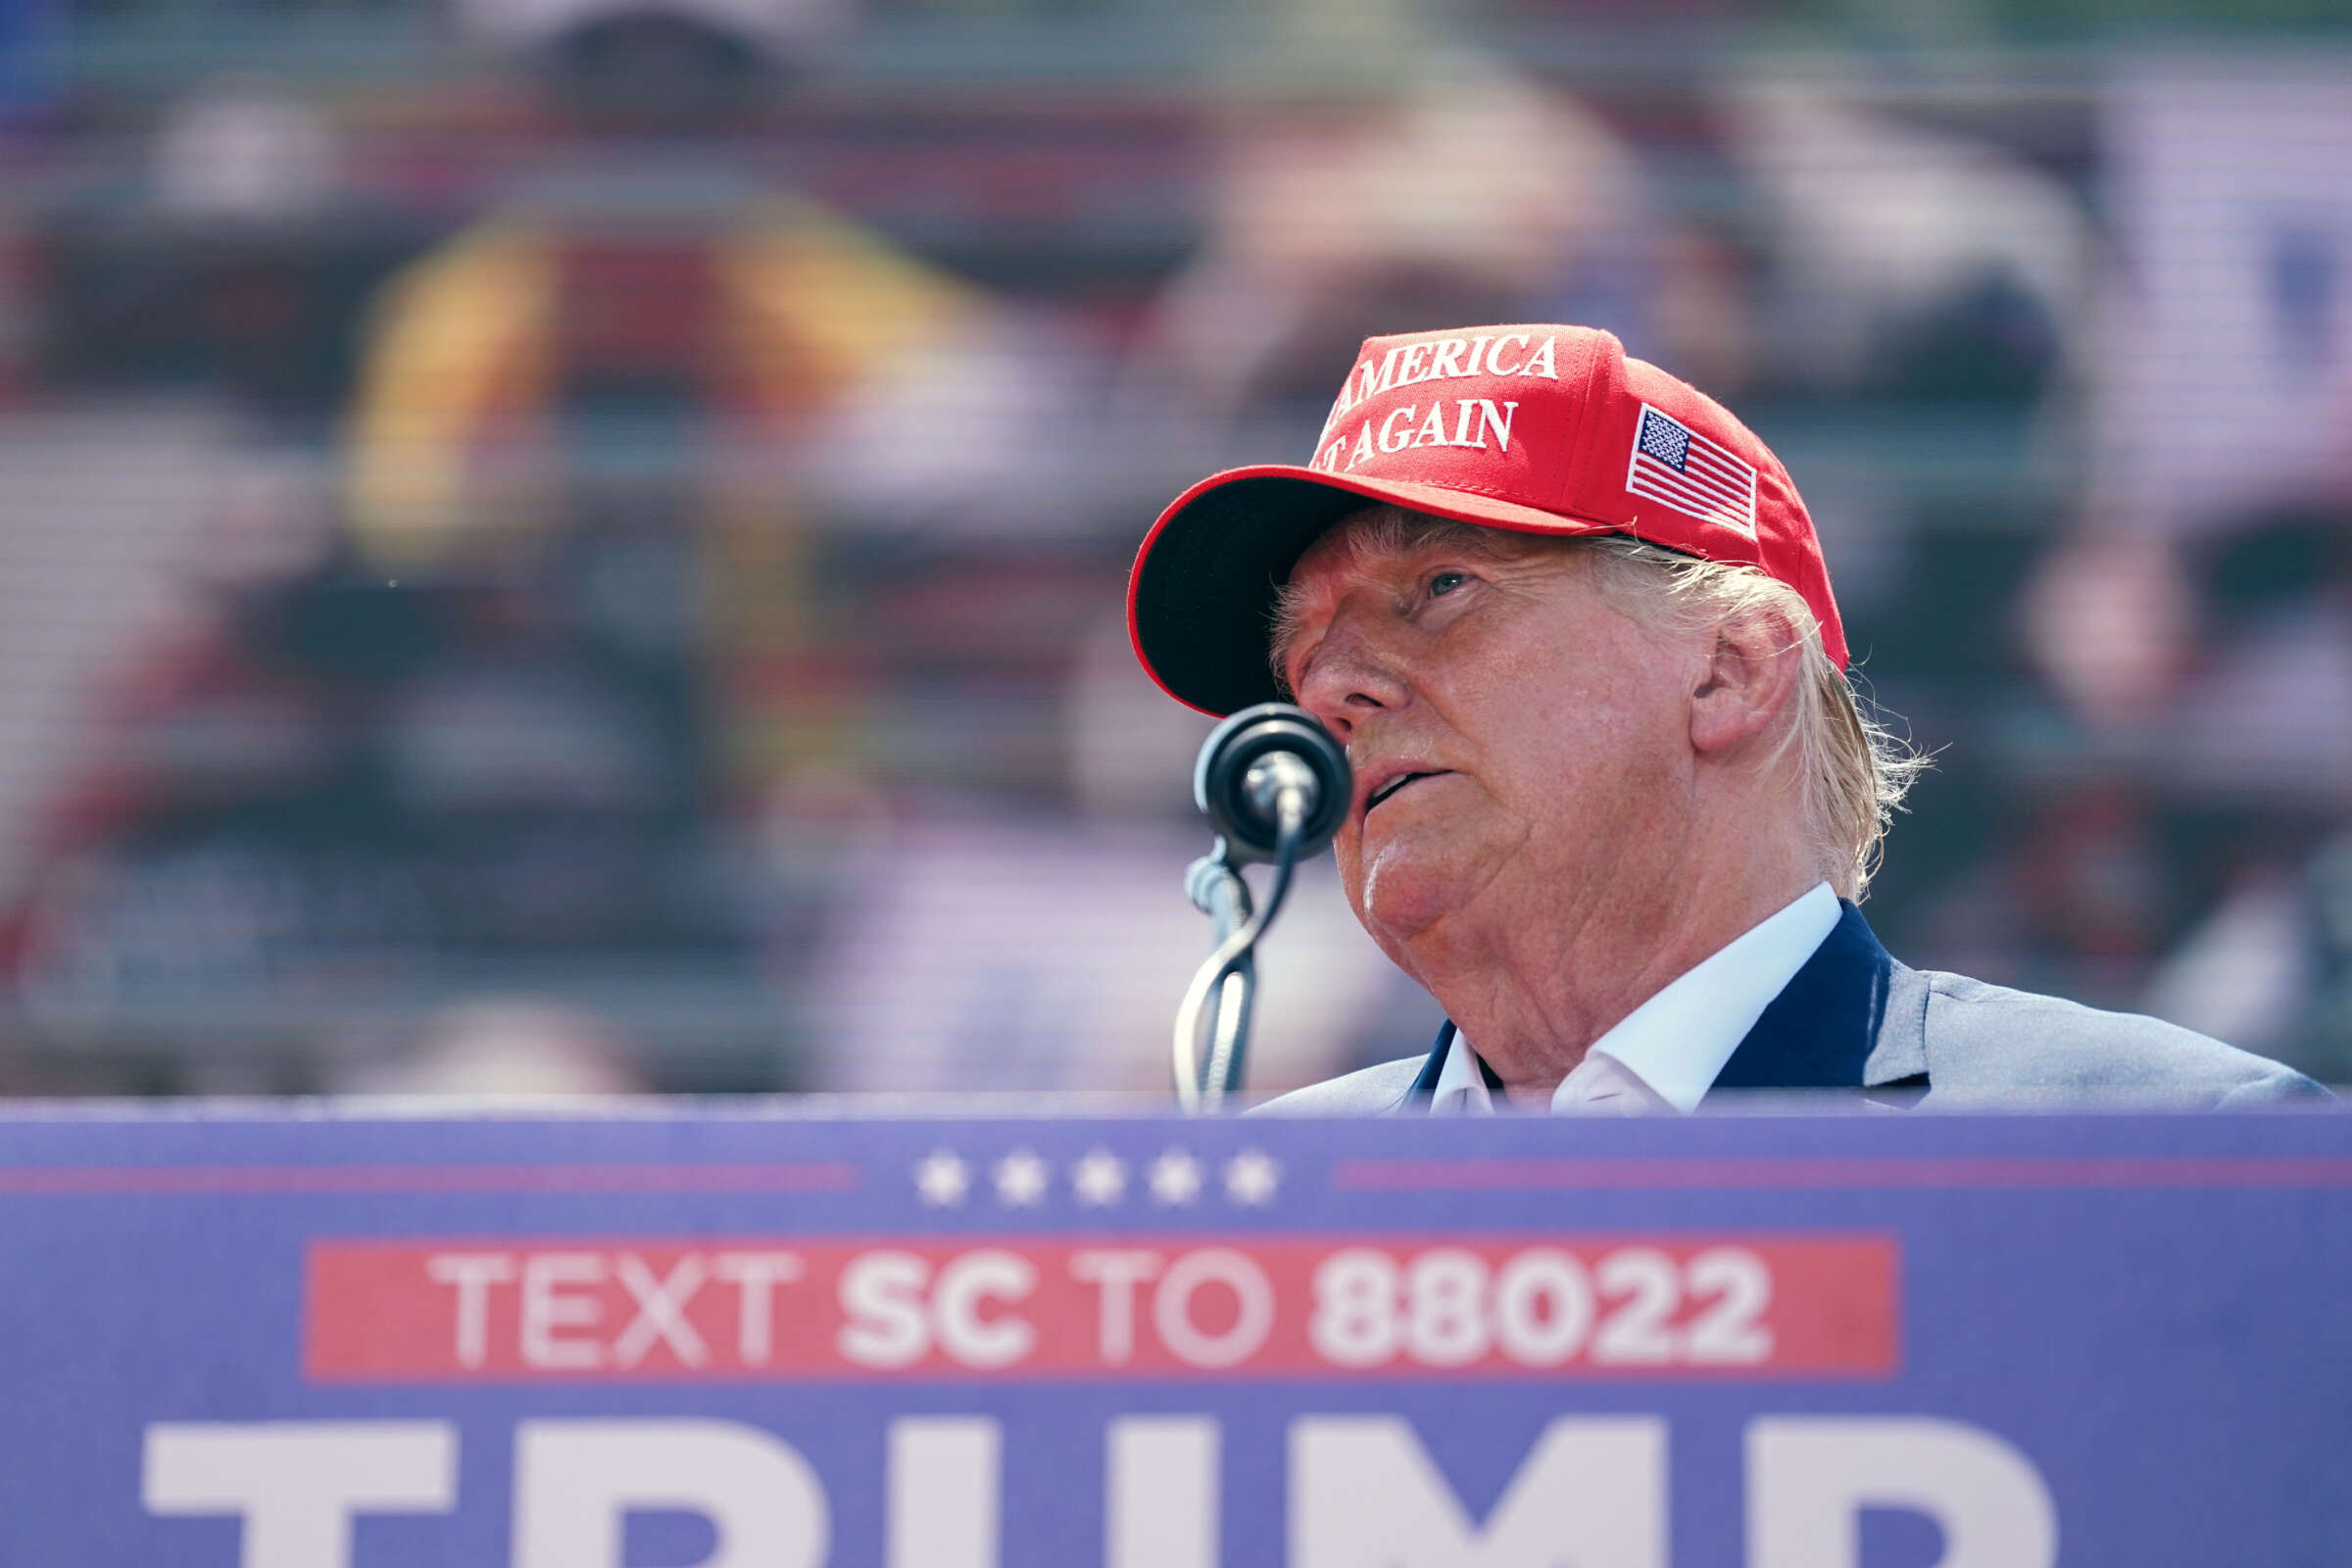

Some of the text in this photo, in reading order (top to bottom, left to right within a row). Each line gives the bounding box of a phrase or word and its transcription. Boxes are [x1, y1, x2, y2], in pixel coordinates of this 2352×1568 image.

[1338, 334, 1558, 418] AMERICA
[1344, 399, 1519, 472] AGAIN
[426, 1246, 1775, 1369] TEXT SC TO 88022
